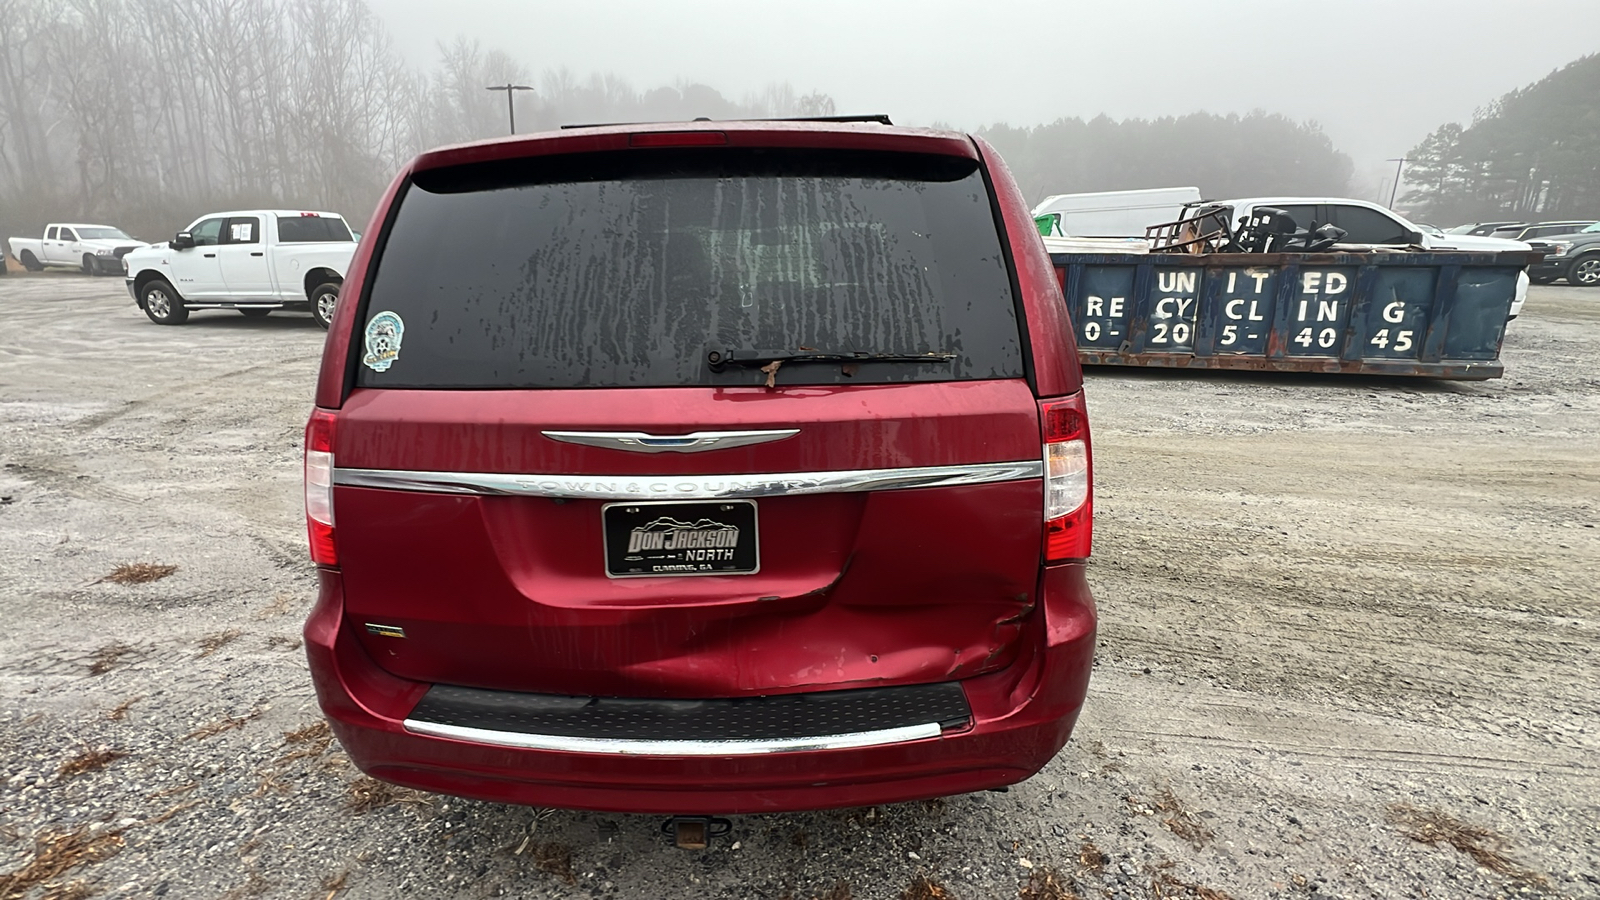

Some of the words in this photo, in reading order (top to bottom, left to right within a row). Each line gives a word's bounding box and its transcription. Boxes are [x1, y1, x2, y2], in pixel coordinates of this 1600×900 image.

[628, 531, 664, 553] DON
[664, 530, 739, 550] JACKSON
[685, 549, 734, 561] NORTH
